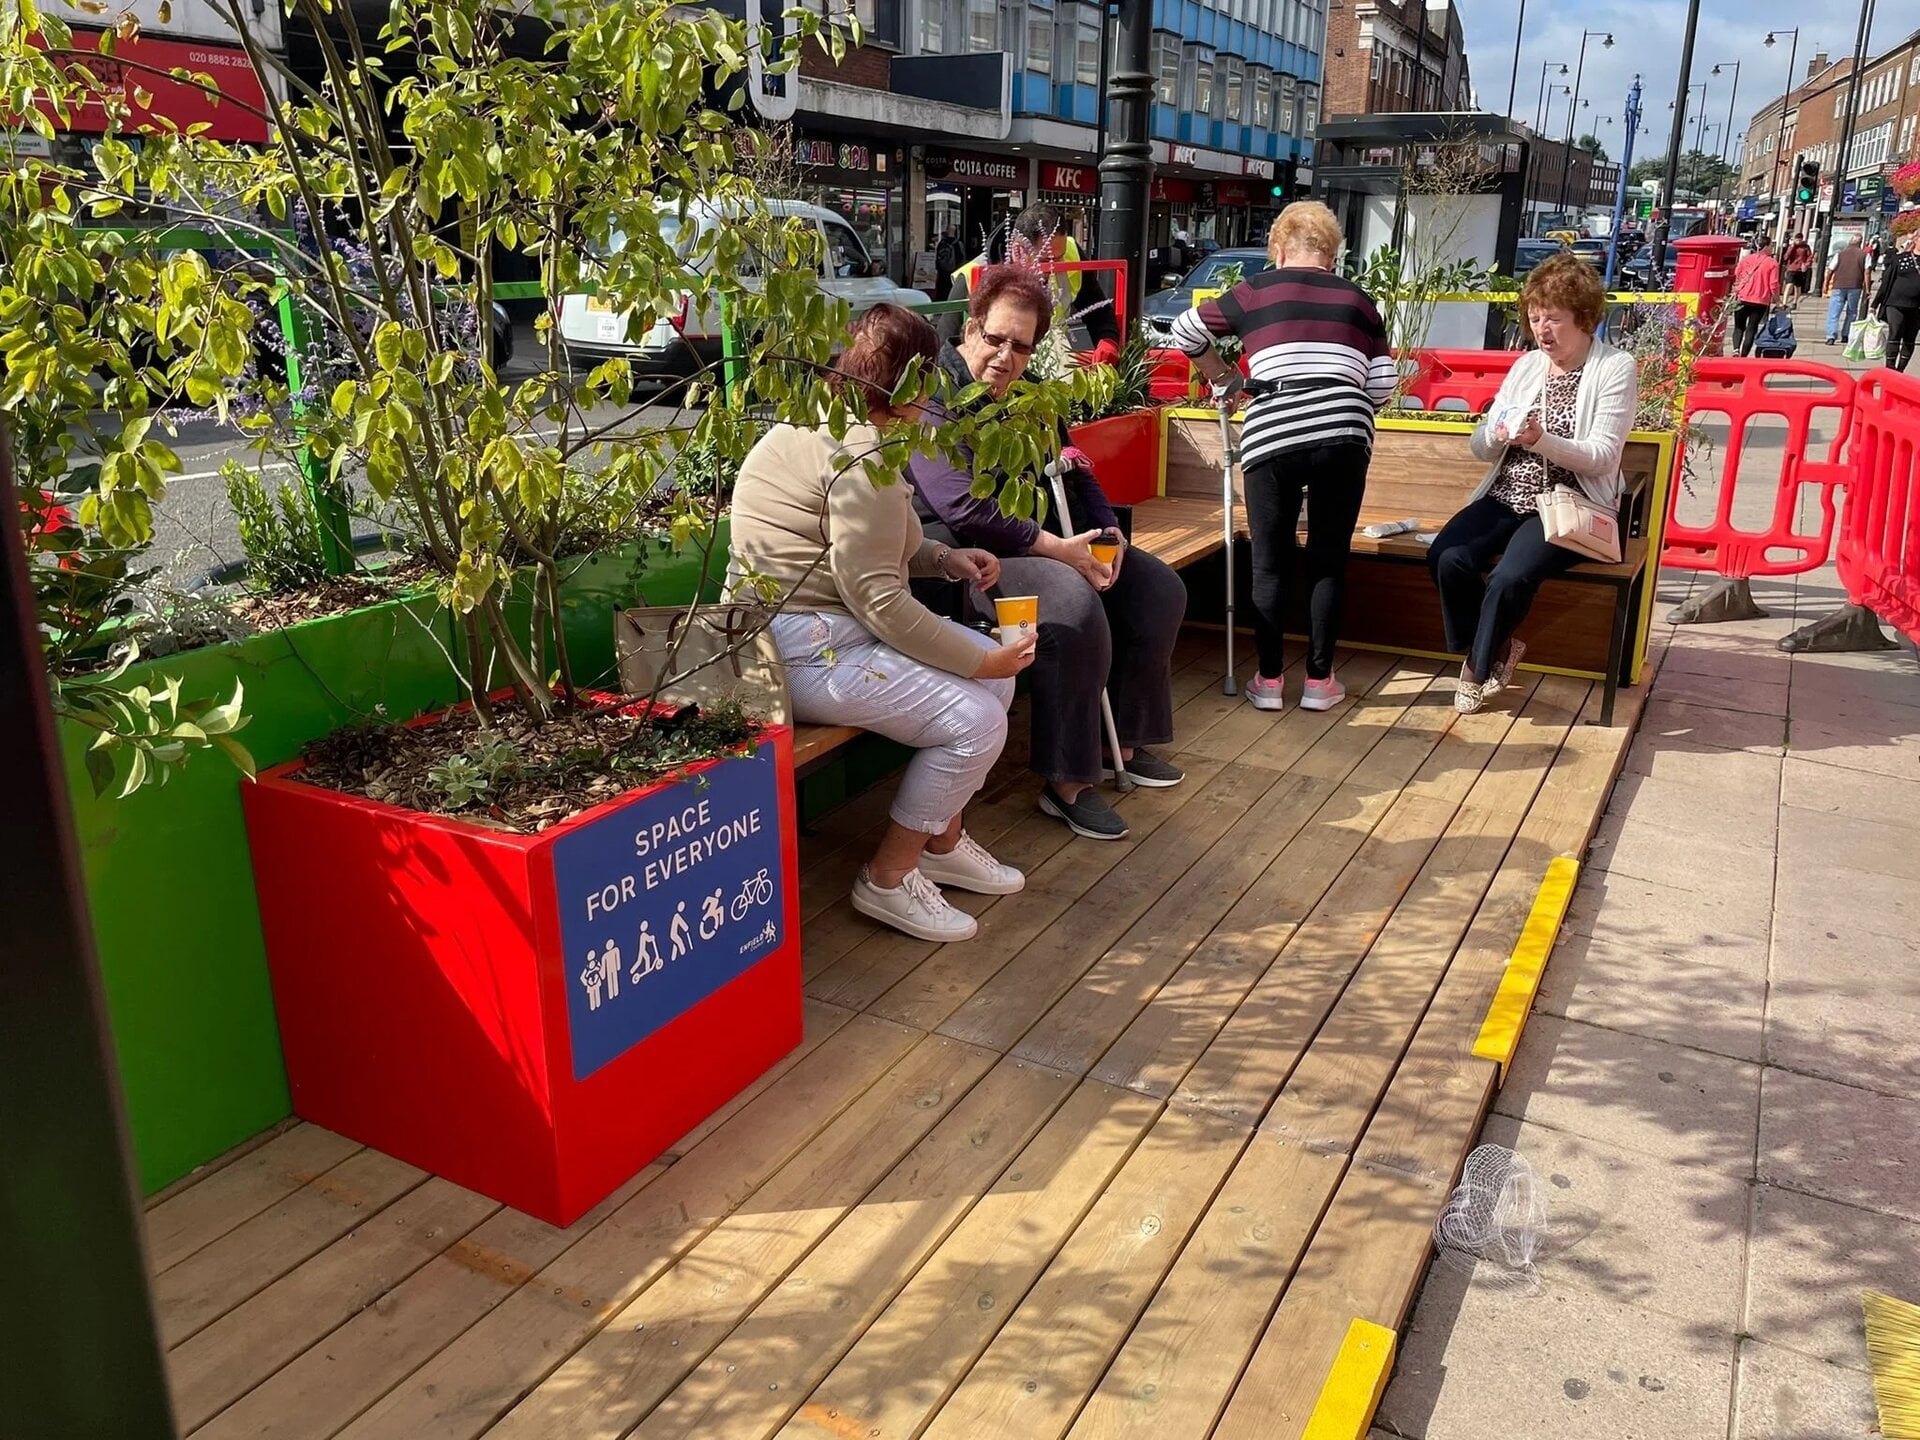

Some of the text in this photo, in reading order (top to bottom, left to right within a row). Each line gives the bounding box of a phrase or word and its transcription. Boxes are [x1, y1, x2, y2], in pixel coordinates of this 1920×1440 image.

[189, 52, 207, 63] 020
[208, 54, 230, 66] 8882
[796, 138, 834, 166] NAIL
[838, 143, 870, 171] SPA
[1172, 145, 1197, 165] KFC
[953, 159, 1016, 178] COSTA COFFEE
[1054, 166, 1082, 190] KFC
[1246, 159, 1265, 176] KFC
[634, 799, 711, 857] SPACE
[585, 808, 762, 922] FOR EVERYONE
